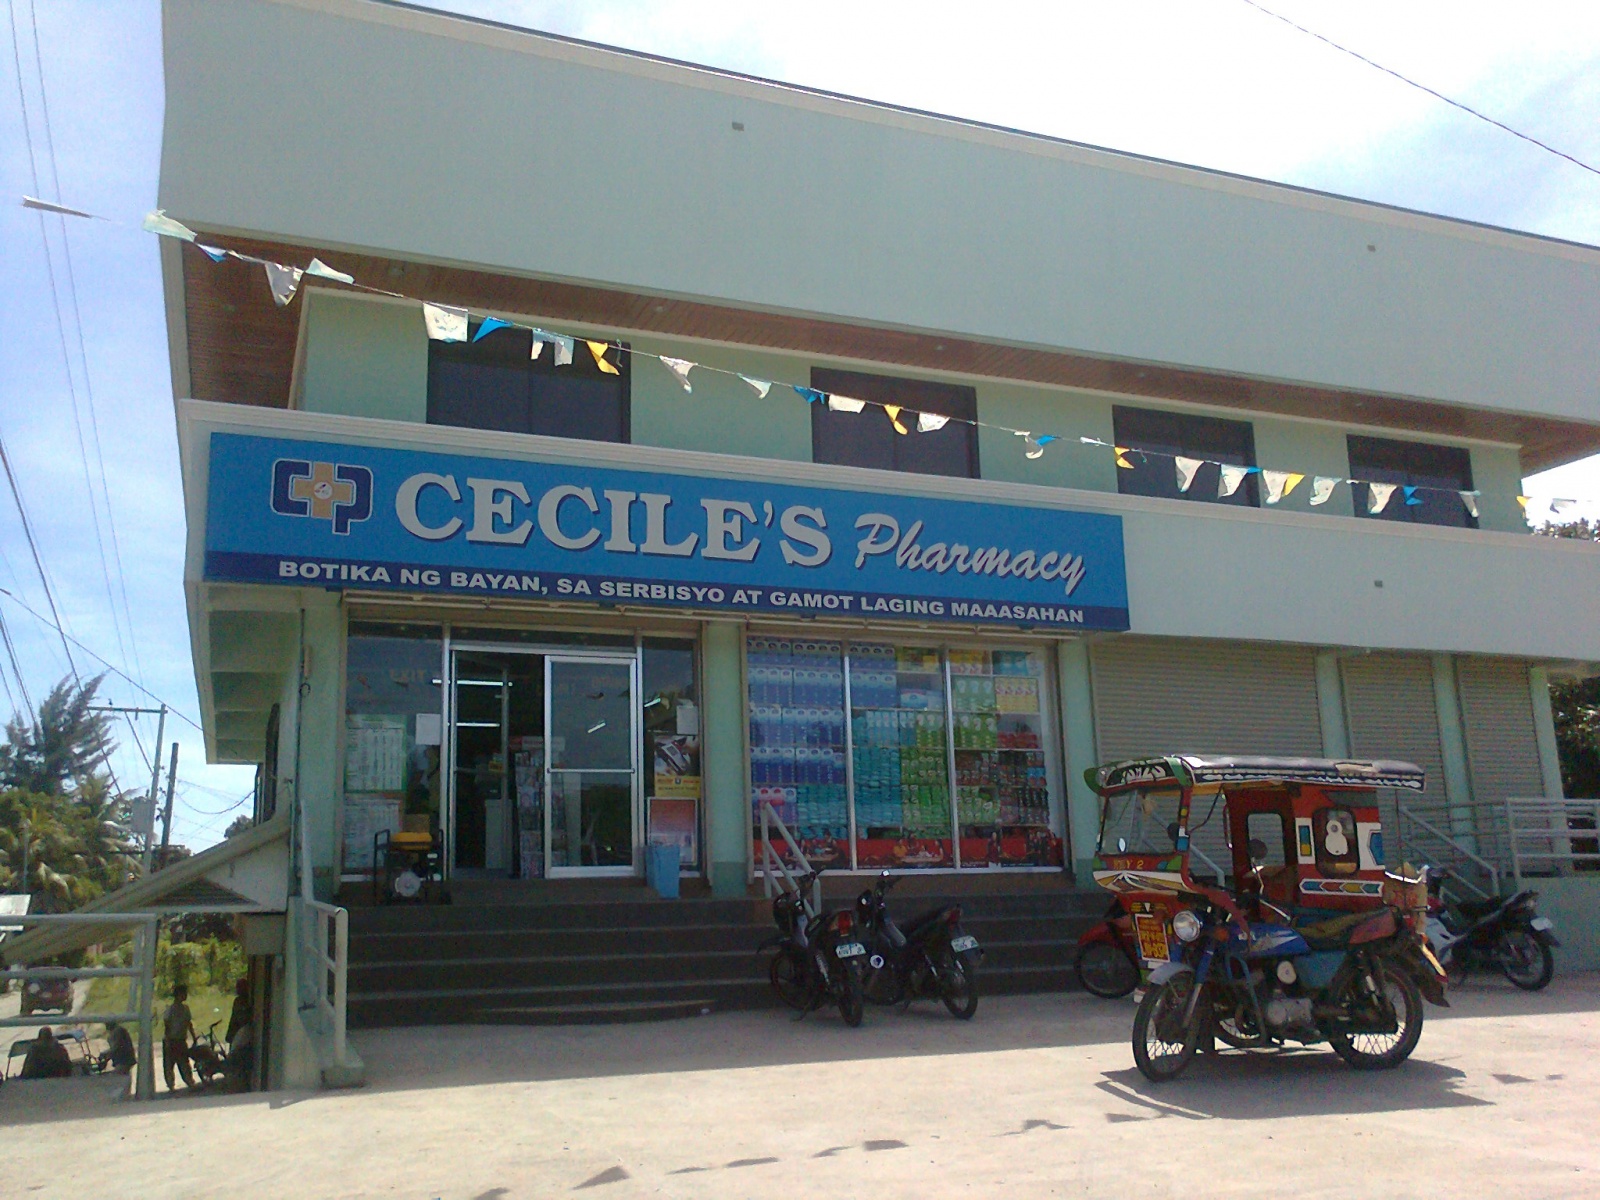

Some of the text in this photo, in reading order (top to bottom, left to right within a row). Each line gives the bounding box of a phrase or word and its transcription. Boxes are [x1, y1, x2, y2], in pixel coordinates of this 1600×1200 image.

[395, 472, 1086, 597] CECILE'S Pharmacy
[278, 560, 1084, 624] BOTIKA NG BAYAN, SA SERBISYO AT GAMOT LAGING MAAASAHAN
